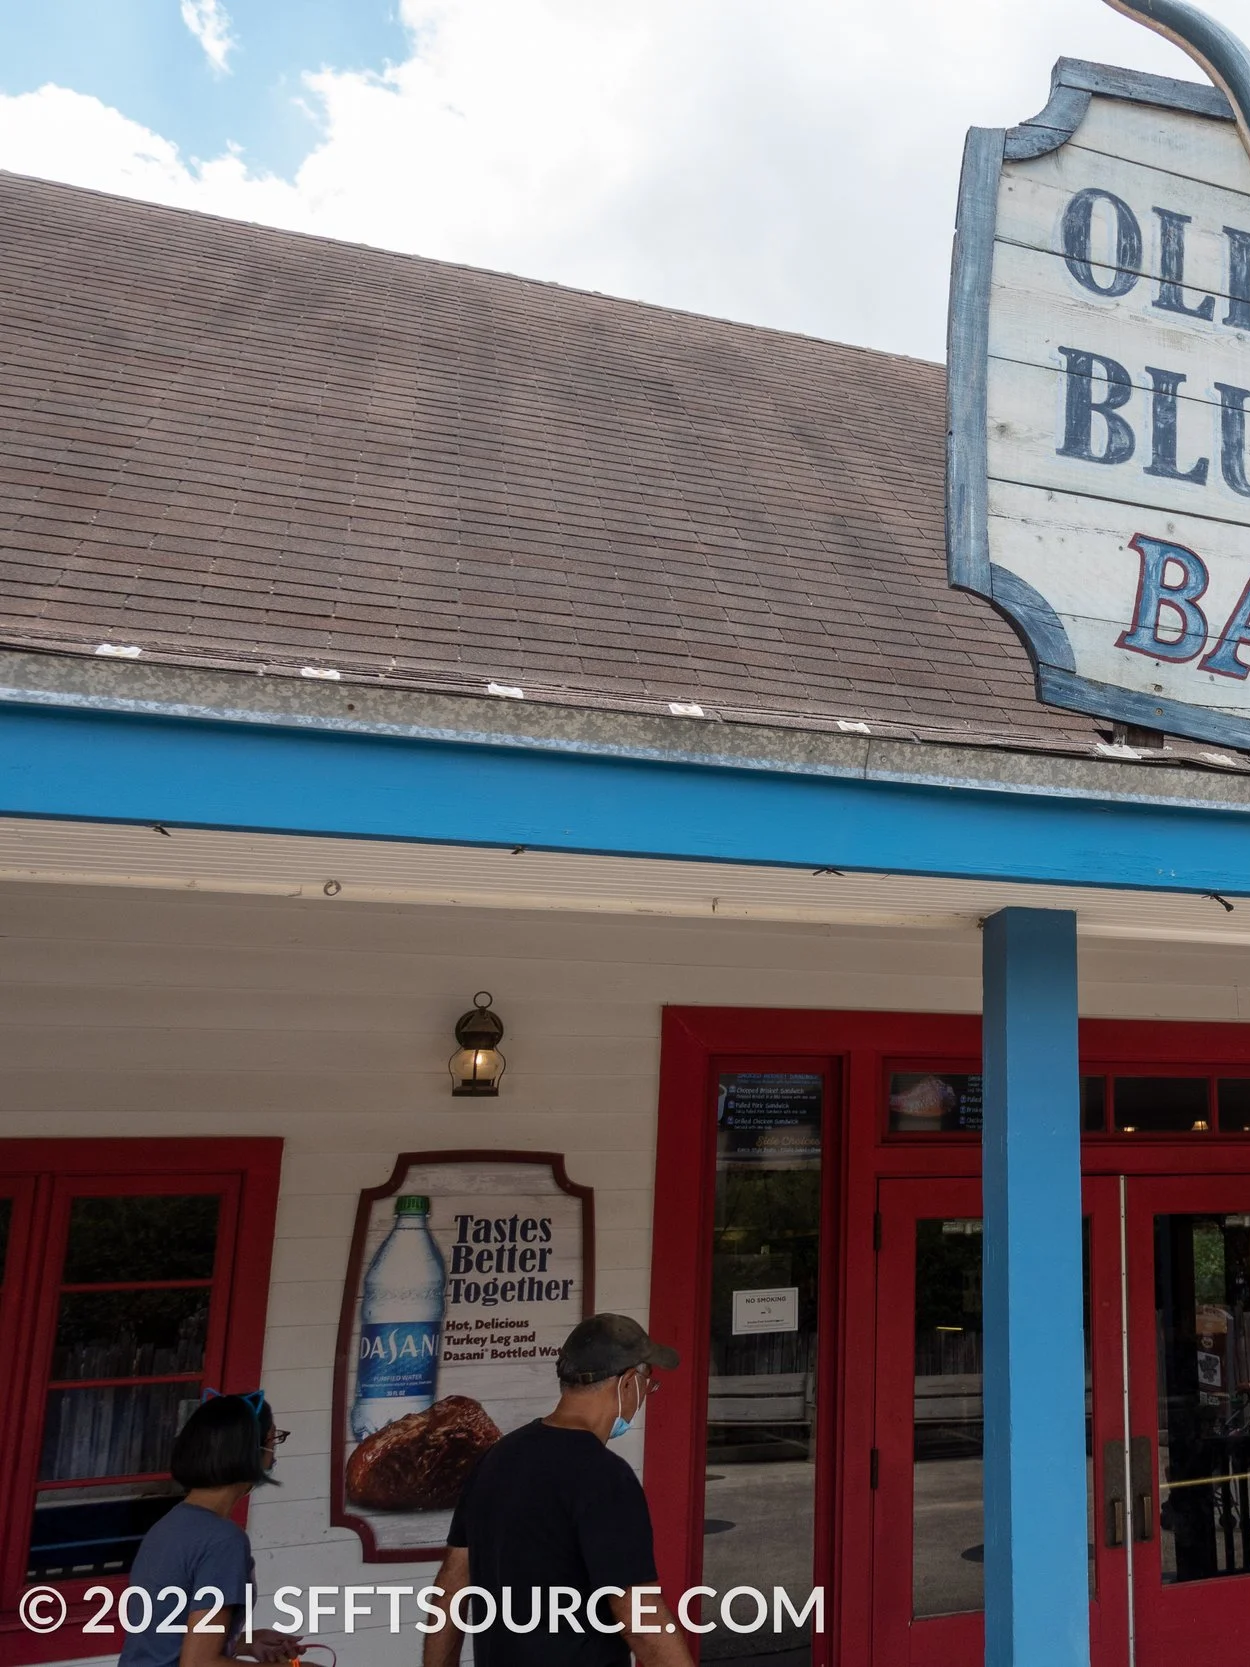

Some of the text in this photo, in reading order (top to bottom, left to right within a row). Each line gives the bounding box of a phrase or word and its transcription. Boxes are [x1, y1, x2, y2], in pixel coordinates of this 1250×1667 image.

[454, 1214, 552, 1244] Tastes
[450, 1244, 552, 1274] Better
[449, 1277, 574, 1306] Together
[445, 1331, 536, 1347] Turkey Leg and
[446, 1318, 529, 1331] Hot, Delicious
[360, 1328, 440, 1365] DASANI
[491, 1346, 536, 1358] Bottled
